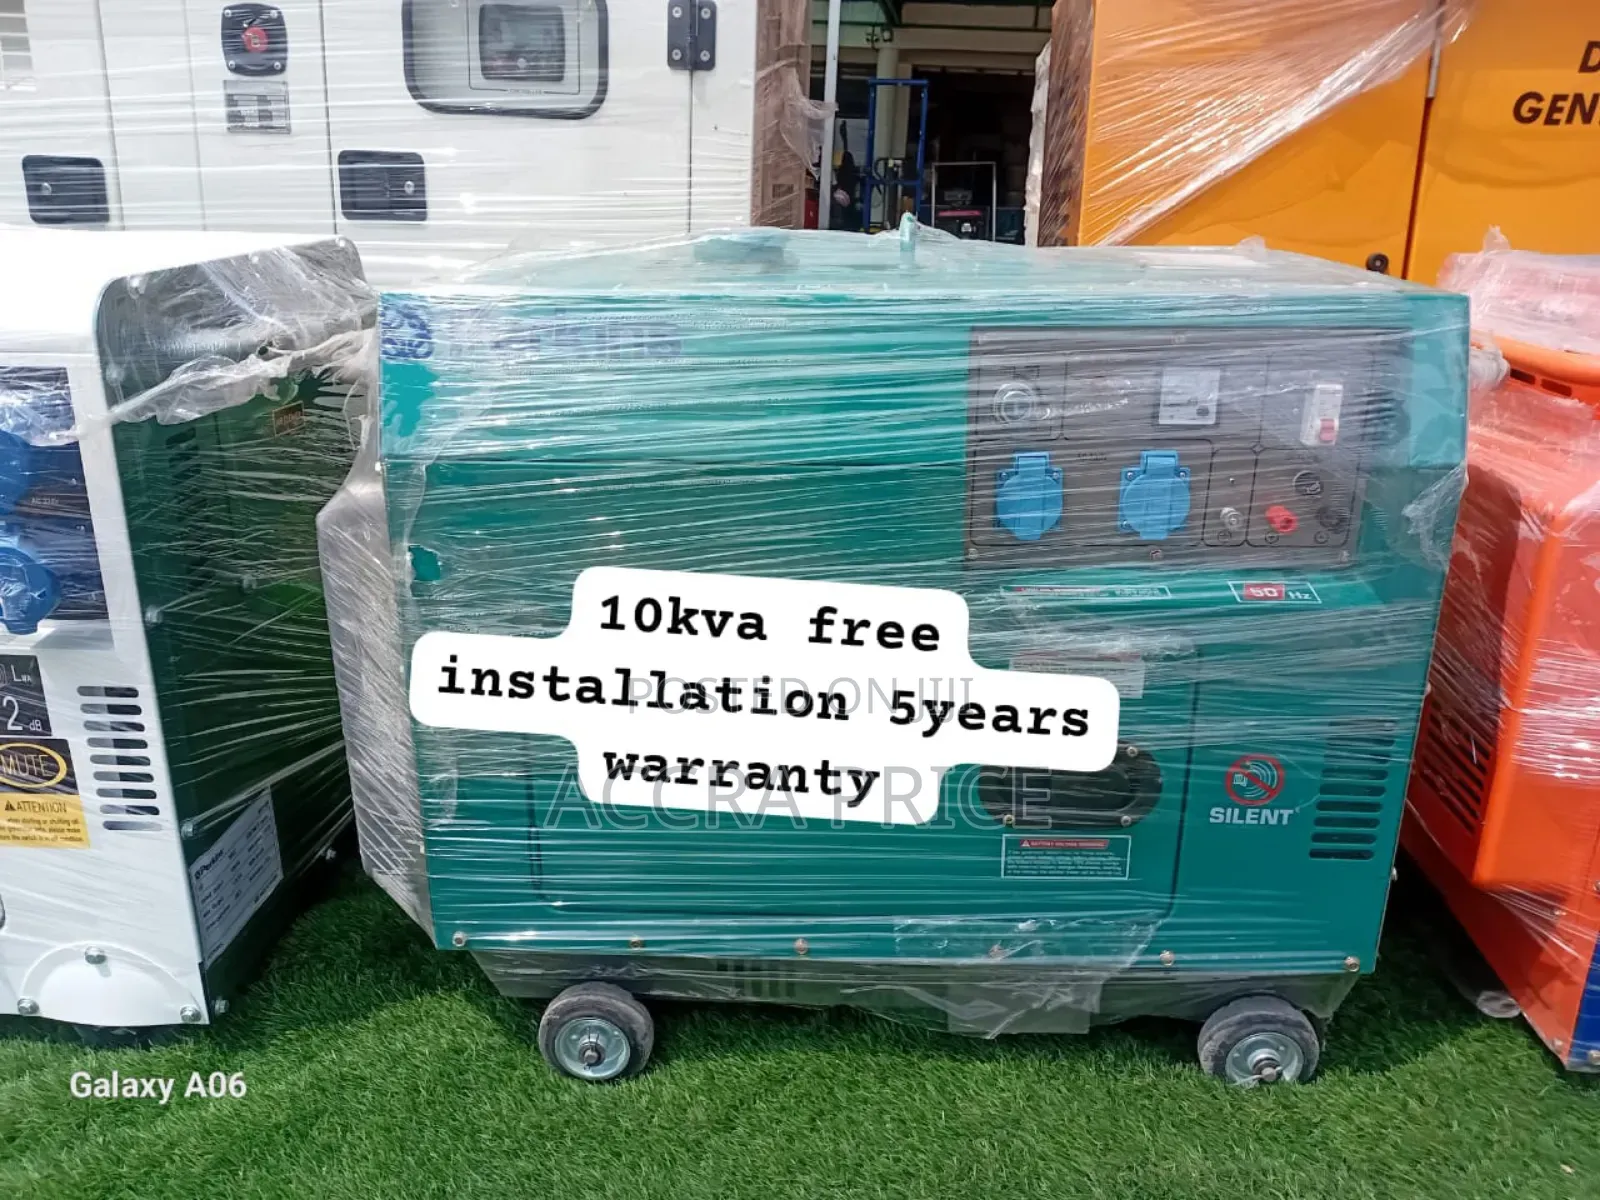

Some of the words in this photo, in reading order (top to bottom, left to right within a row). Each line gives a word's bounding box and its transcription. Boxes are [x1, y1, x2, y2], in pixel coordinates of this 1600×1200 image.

[1513, 91, 1600, 126] GEN
[0, 753, 56, 777] MUTE
[17, 801, 67, 813] ATTENTION
[1209, 807, 1294, 825] SILENT
